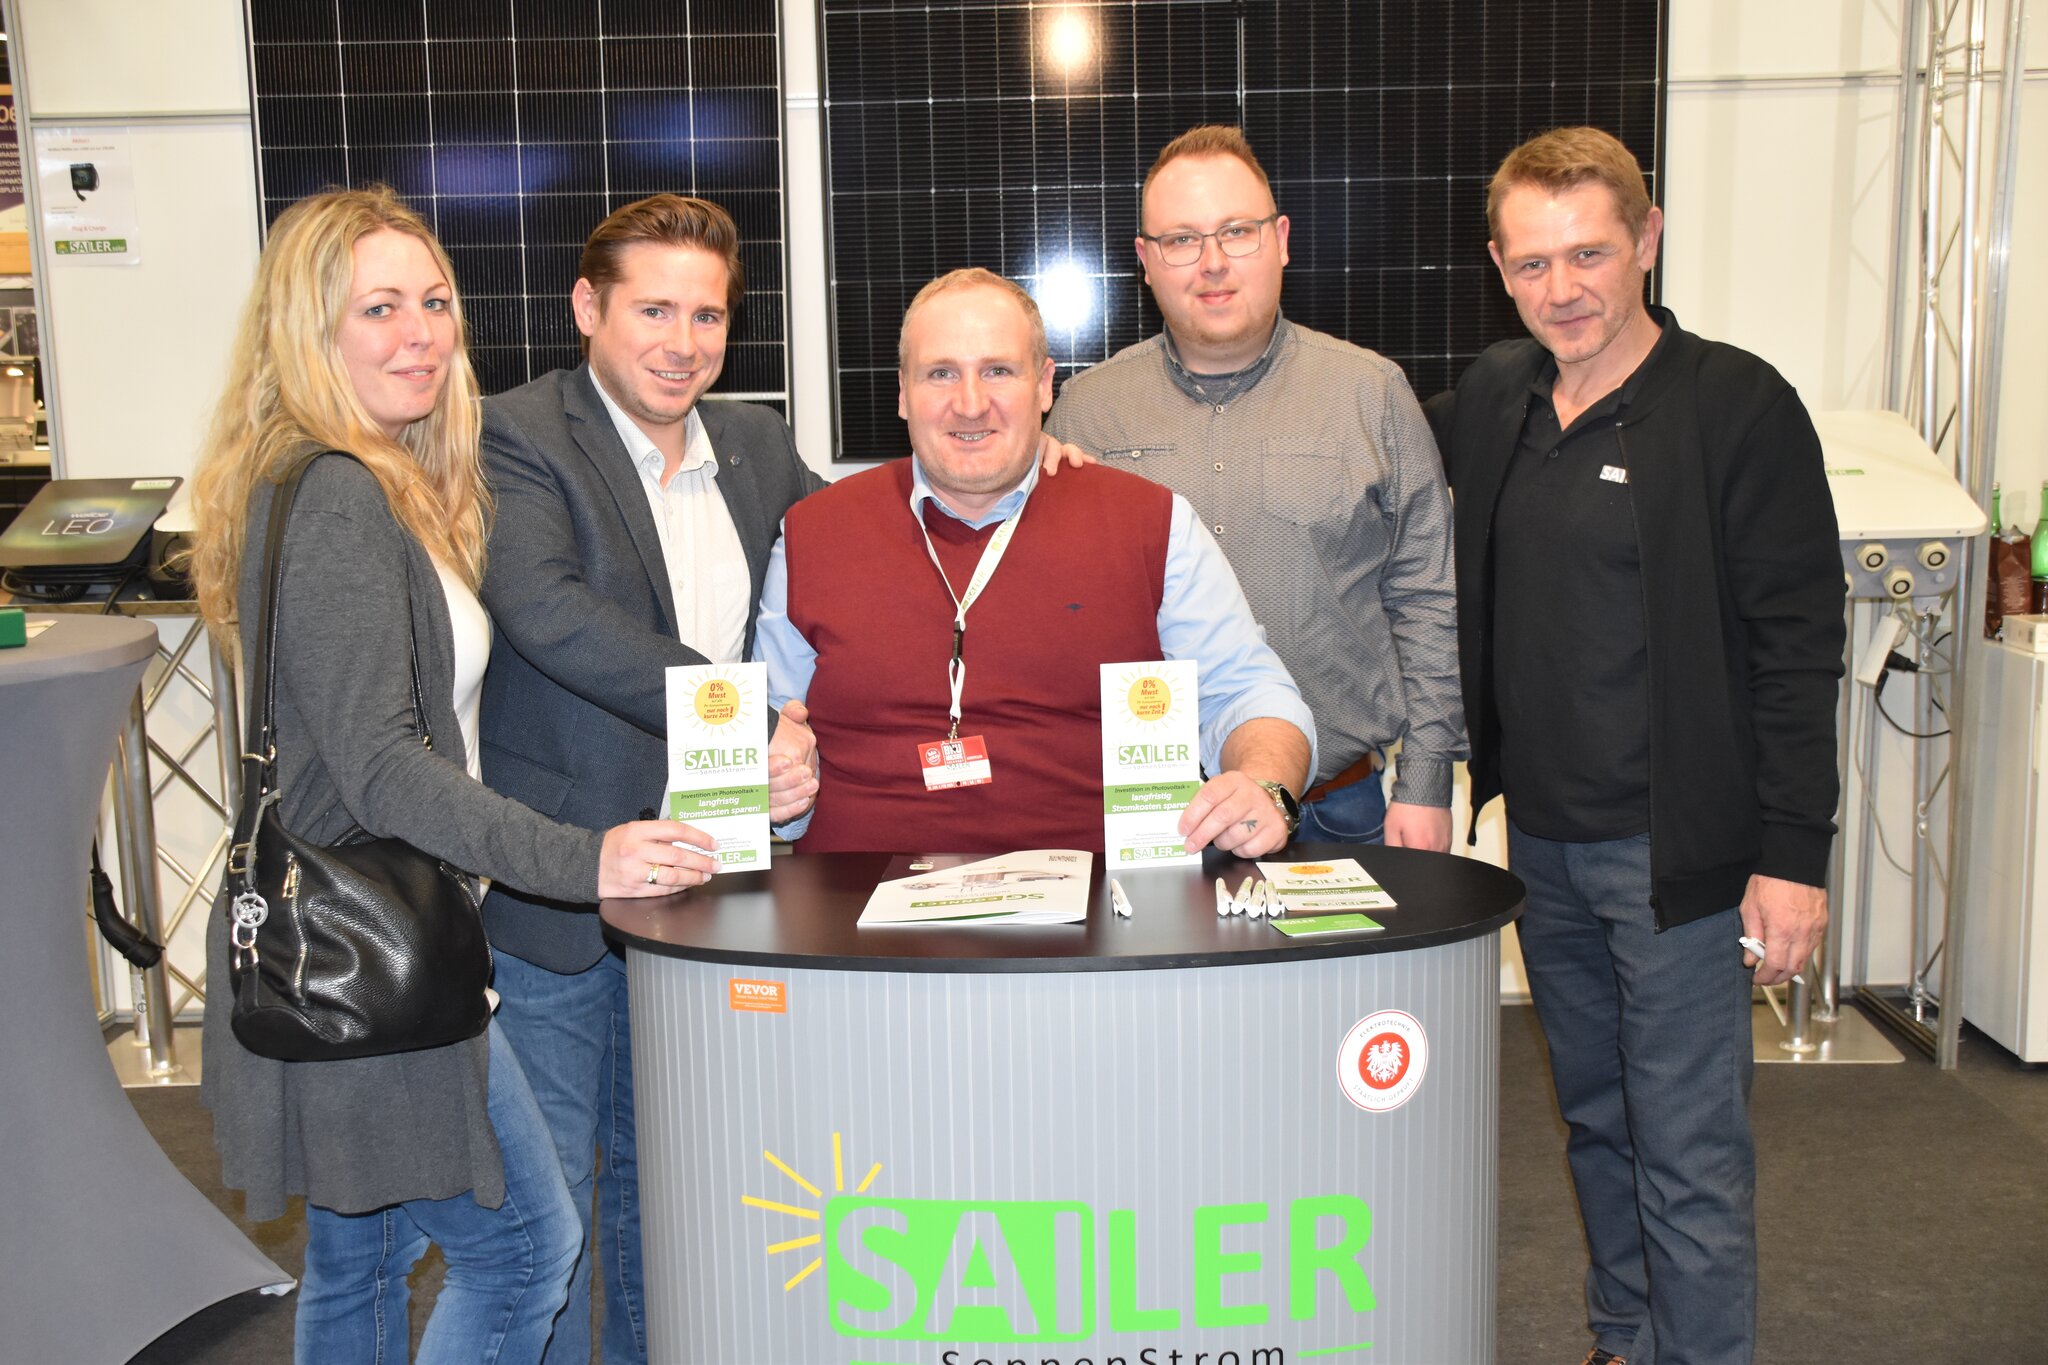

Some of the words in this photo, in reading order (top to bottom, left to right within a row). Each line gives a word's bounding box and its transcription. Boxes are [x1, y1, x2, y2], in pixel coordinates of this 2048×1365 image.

[41, 518, 114, 535] LEO
[710, 682, 724, 692] 0%
[1142, 679, 1156, 689] 0%
[685, 748, 758, 770] SAILER
[1119, 744, 1189, 765] SAILER
[681, 791, 711, 799] Investition
[719, 788, 754, 796] Photovoltaik
[1131, 791, 1172, 802] langfristig
[699, 796, 740, 807] langfristig
[1112, 802, 1162, 812] Stromkosten
[678, 807, 730, 819] Stromkosten
[731, 804, 761, 814] sparen!
[734, 983, 778, 996] VEVOR
[1359, 1019, 1411, 1038] ELEKTROTECHNIK
[1353, 1085, 1386, 1102] STAATLICH
[832, 1194, 1377, 1336] SAILER
